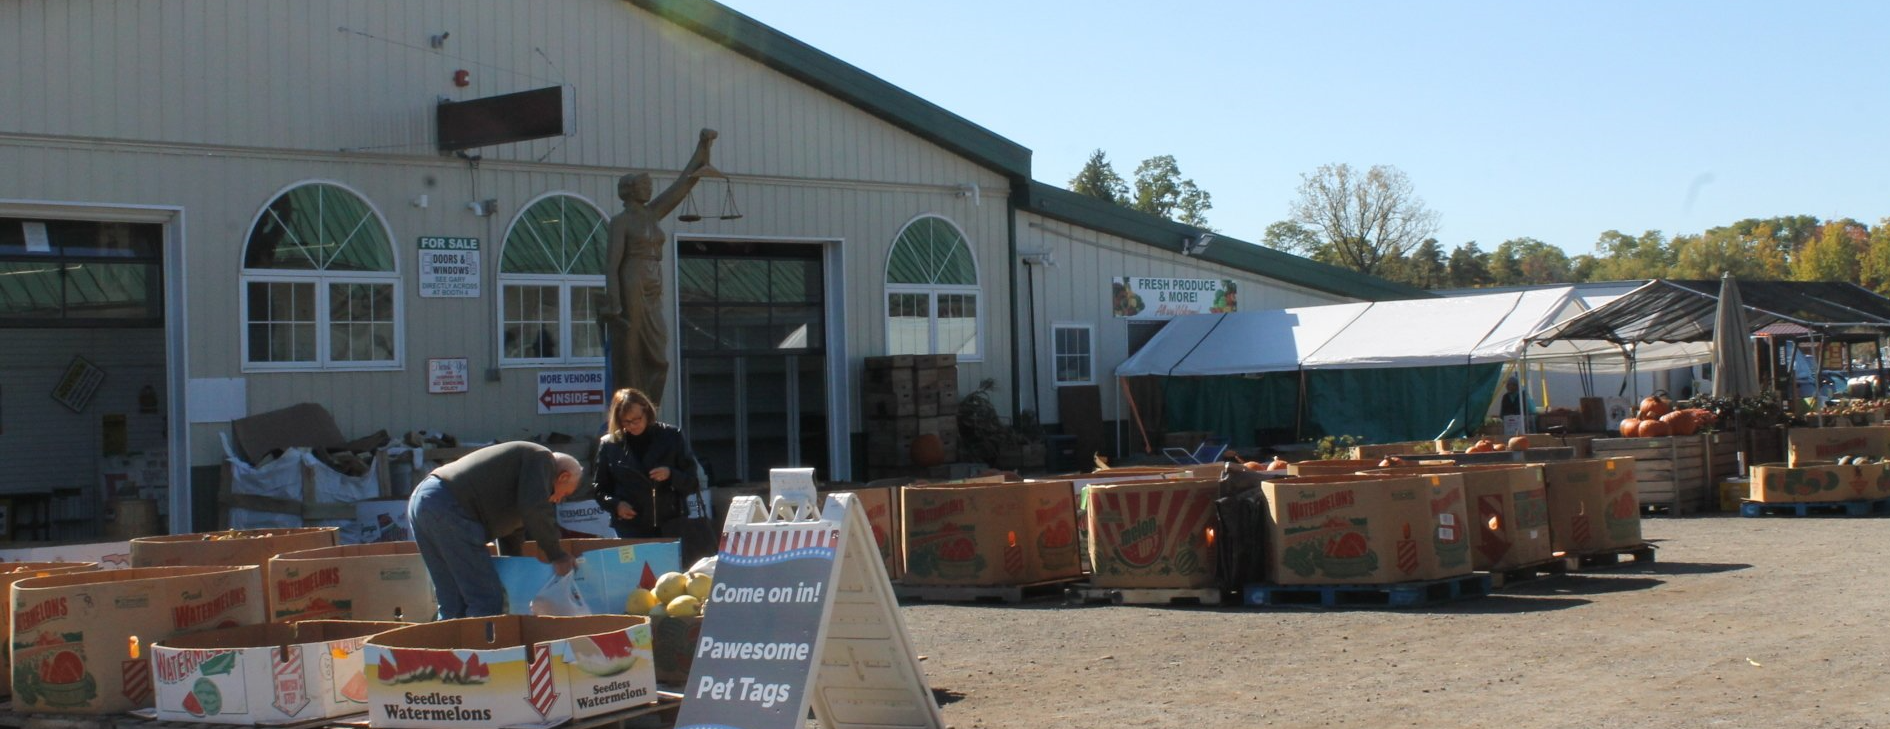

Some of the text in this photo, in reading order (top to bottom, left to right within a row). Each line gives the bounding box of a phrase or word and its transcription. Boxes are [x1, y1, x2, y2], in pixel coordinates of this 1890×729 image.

[421, 238, 478, 249] FOR SALE
[433, 254, 466, 264] DOORS &
[433, 266, 469, 275] WINDOWS
[1138, 279, 1216, 291] FRESH PRODUCE
[1160, 291, 1198, 303] & MORE!
[540, 373, 602, 385] MORE VENDORS
[552, 392, 589, 404] INSIDE
[277, 567, 340, 602] WATERMELONS
[711, 582, 822, 603] Come on in!
[172, 586, 247, 628] WATERMELONS
[697, 636, 809, 660] Pawesome
[592, 679, 631, 695] Seedless
[696, 676, 791, 708] Pet Tags
[405, 691, 462, 705] Seedless
[576, 685, 648, 710] Watermelons
[384, 704, 492, 721] Watermelons
